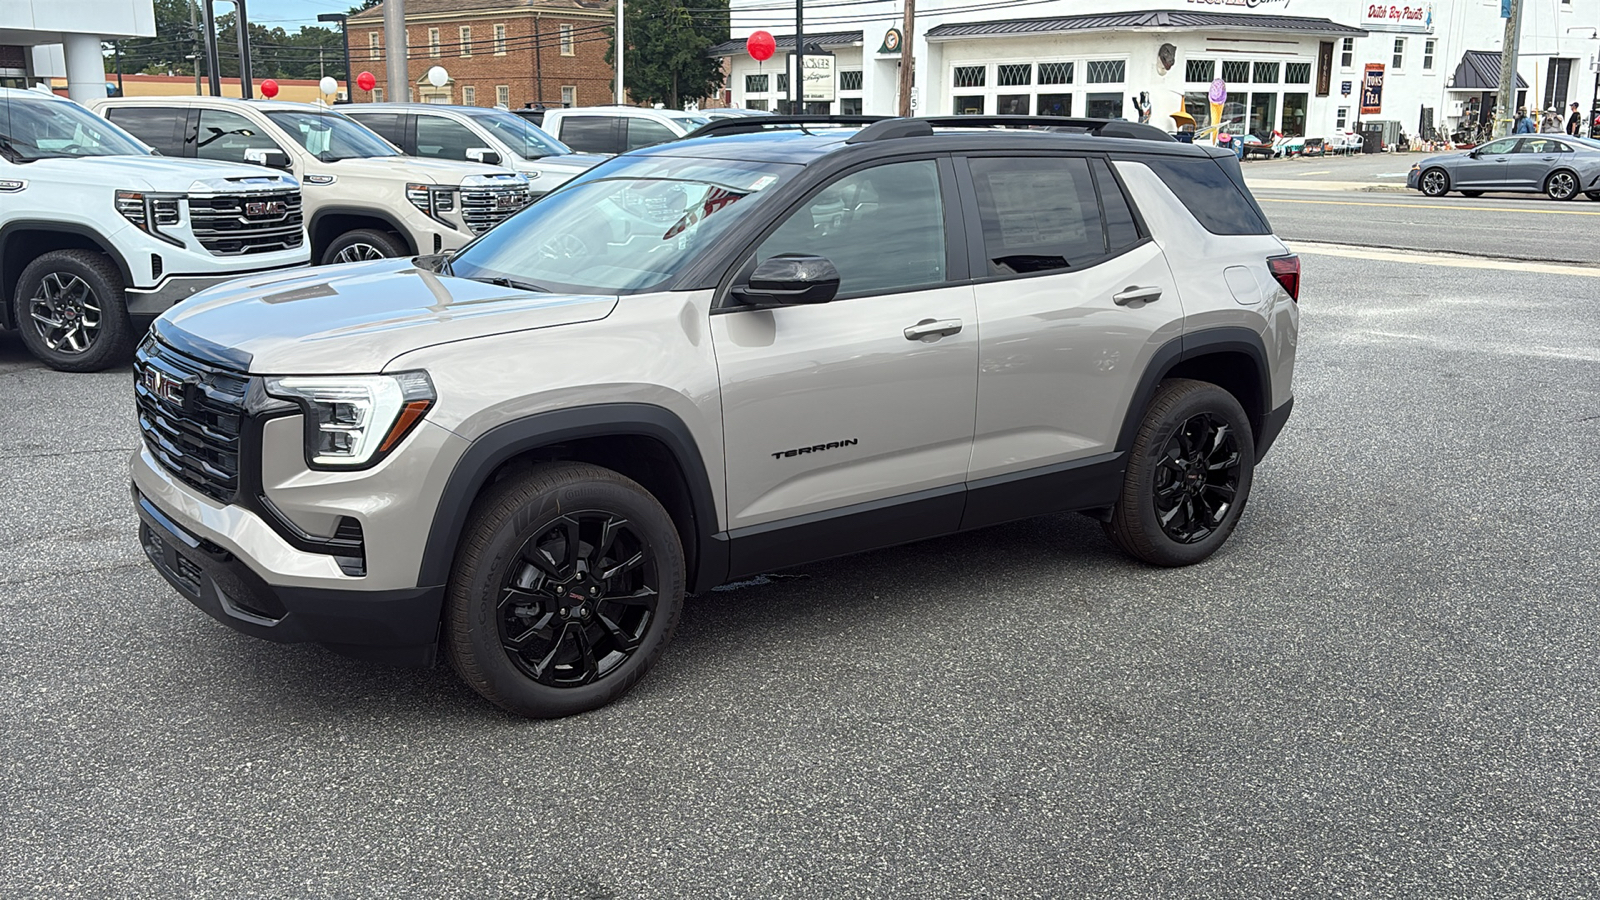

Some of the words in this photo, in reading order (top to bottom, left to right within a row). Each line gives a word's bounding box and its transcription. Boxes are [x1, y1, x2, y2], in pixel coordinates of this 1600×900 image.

[1368, 4, 1387, 18] Dutch
[1389, 5, 1402, 22] Boy
[1402, 6, 1424, 20] Paints
[1366, 92, 1379, 105] TEA
[245, 201, 286, 216] GMC
[145, 365, 184, 408] GMC
[771, 438, 858, 460] TERRAIN
